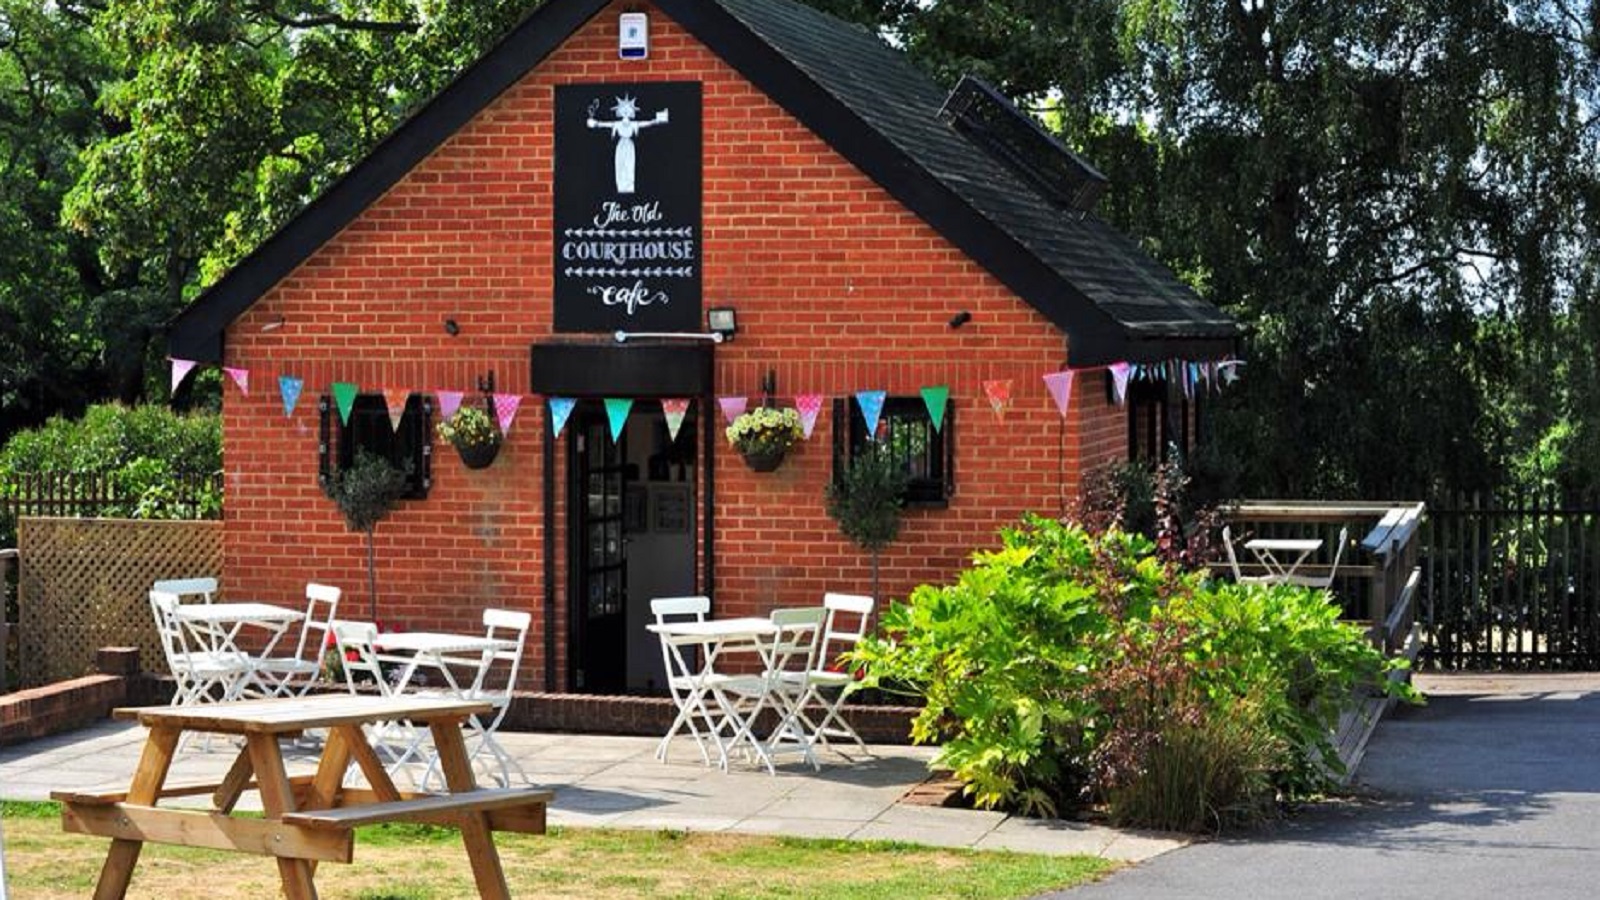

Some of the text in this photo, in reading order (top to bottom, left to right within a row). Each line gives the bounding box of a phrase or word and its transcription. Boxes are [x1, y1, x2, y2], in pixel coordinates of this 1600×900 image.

[594, 201, 662, 228] The Old
[563, 240, 693, 265] COURTHOUSE
[595, 280, 660, 315] cafe
